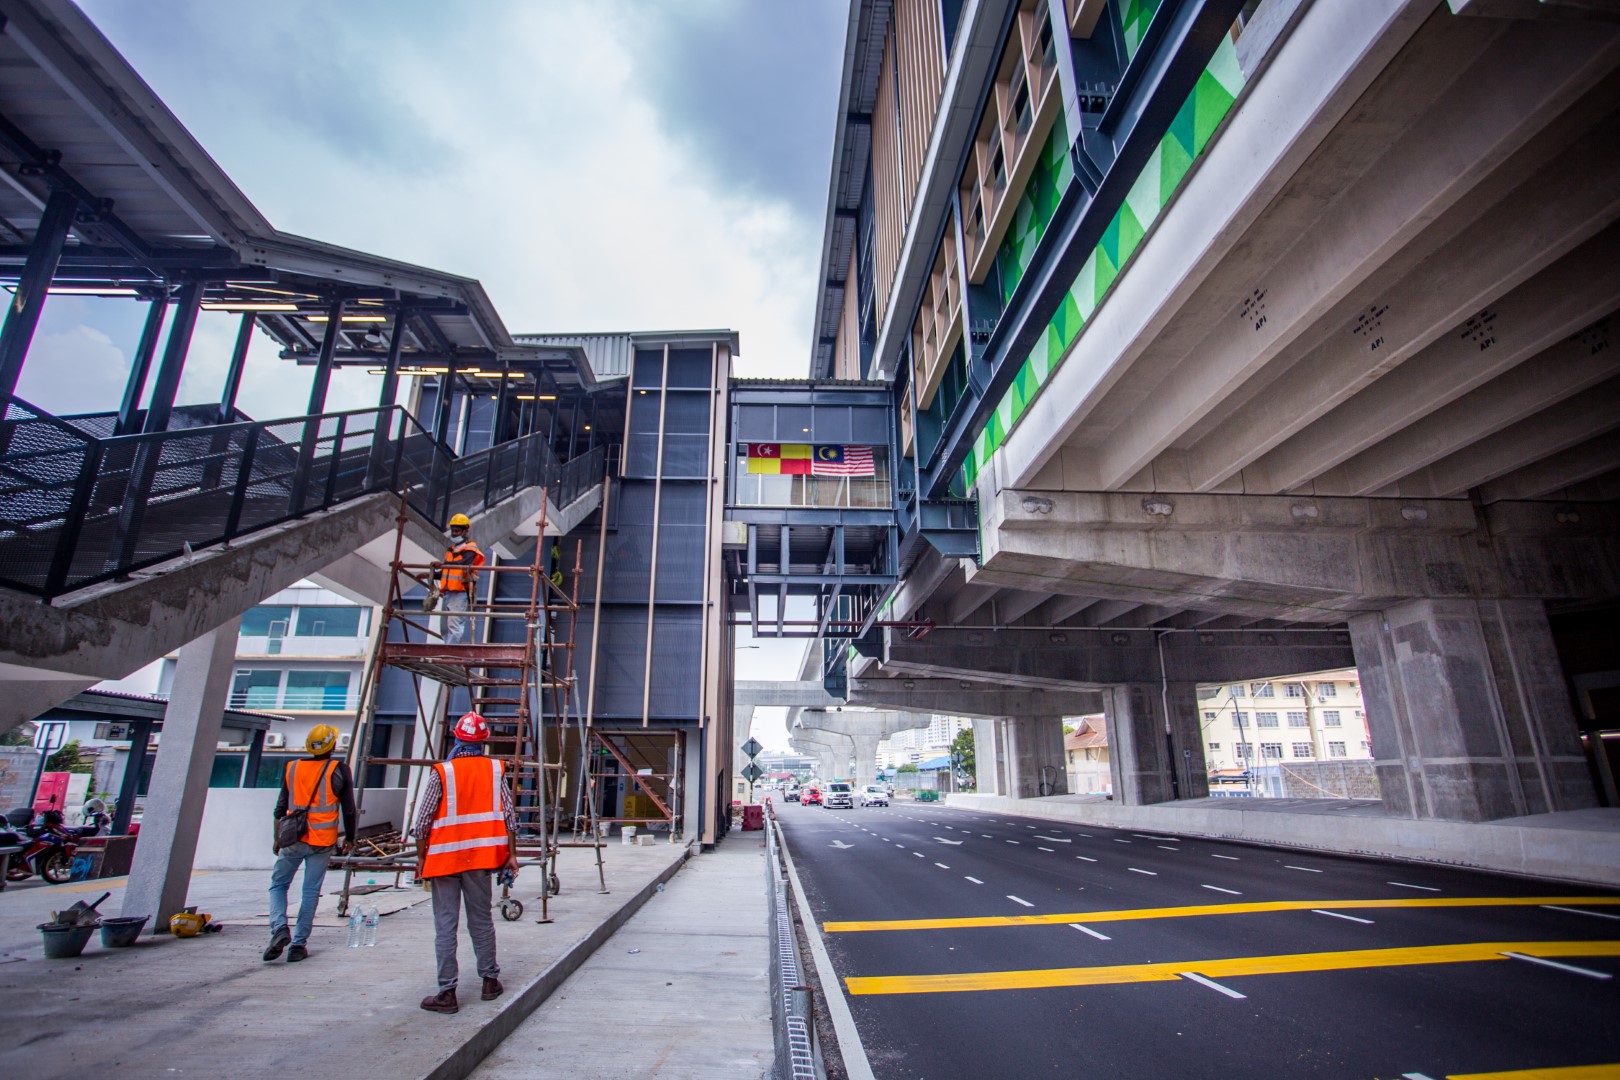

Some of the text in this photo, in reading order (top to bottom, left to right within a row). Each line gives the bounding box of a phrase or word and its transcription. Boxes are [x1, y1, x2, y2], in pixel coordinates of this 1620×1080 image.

[1256, 315, 1267, 331] API
[1371, 336, 1384, 351] API
[1480, 337, 1495, 351] API
